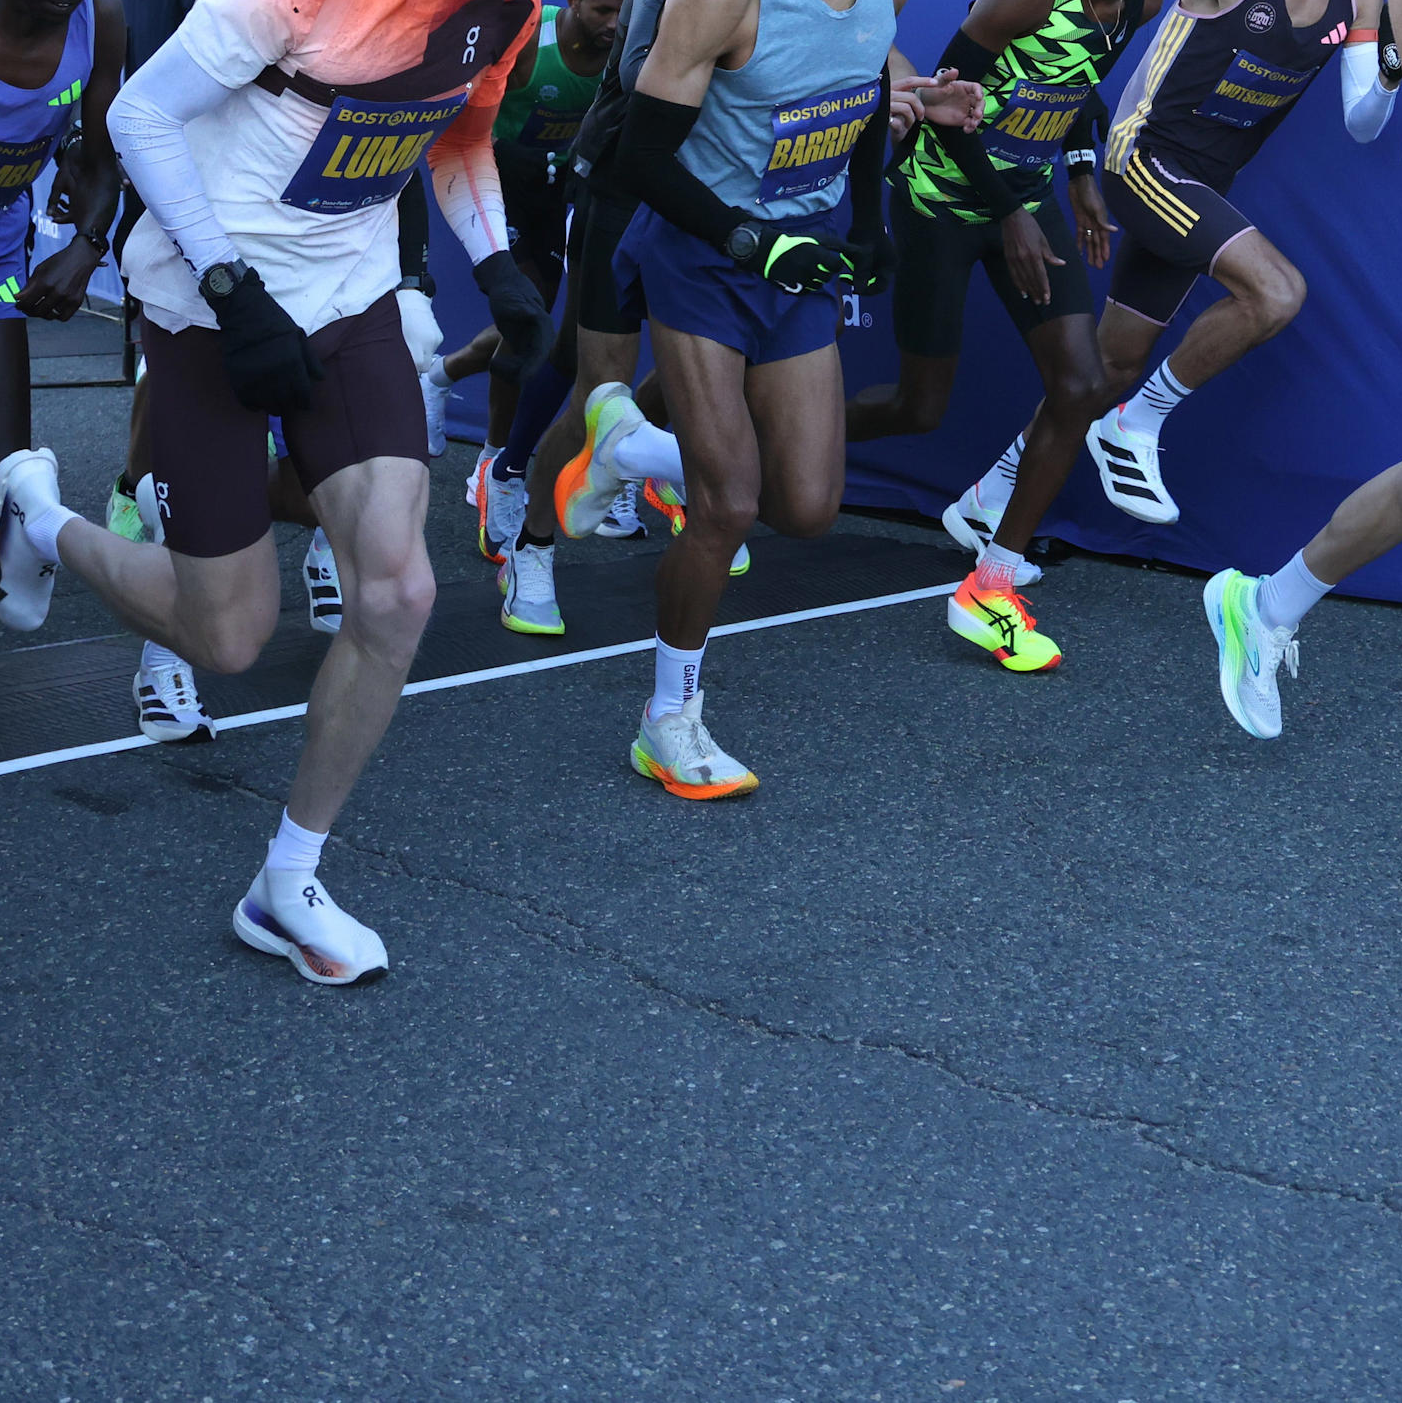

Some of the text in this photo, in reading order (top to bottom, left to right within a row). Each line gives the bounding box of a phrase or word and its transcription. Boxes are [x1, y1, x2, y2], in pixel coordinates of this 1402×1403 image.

[1017, 87, 1067, 104] BOSTON
[336, 105, 462, 126] BOSTON HALF
[779, 89, 876, 124] BOSTON HALF
